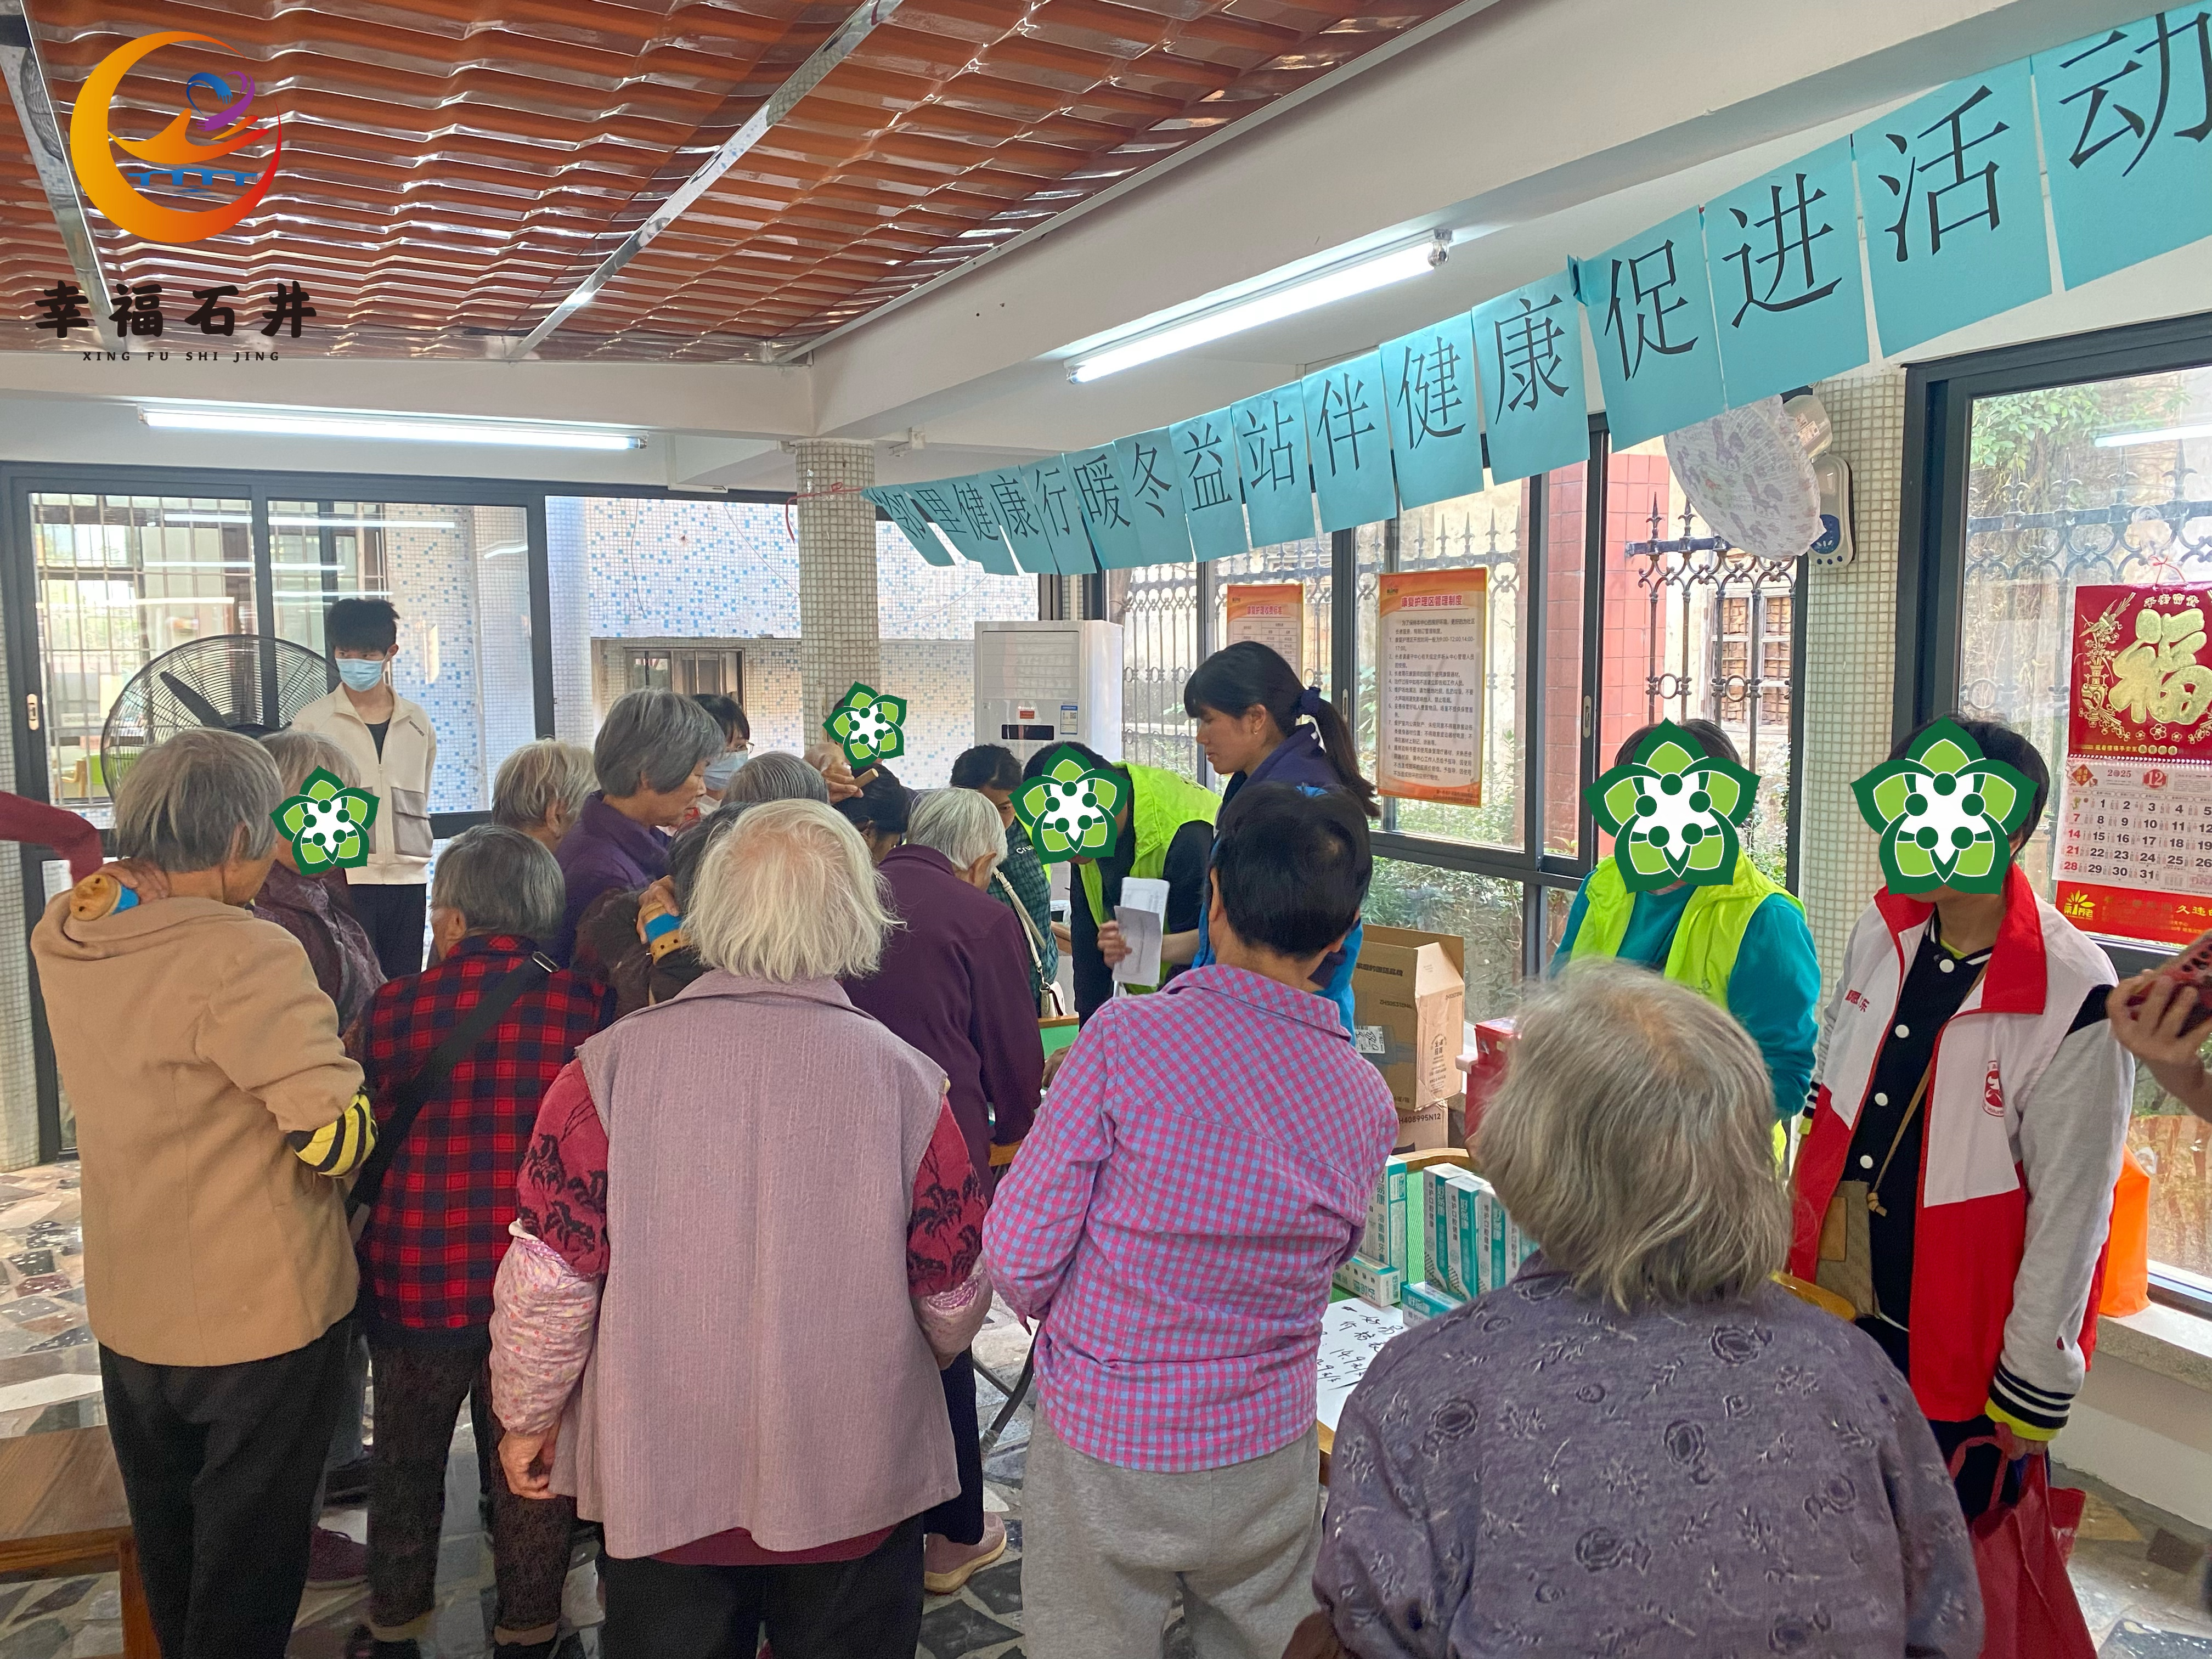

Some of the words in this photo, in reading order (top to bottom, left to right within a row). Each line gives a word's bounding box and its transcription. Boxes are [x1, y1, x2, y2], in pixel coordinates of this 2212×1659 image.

[1401, 595, 1463, 608] 康复护理区管理制度
[2108, 608, 2212, 725] 福
[2147, 771, 2163, 786] 12
[2101, 799, 2105, 808] 1
[2123, 801, 2130, 809] 2
[2148, 803, 2155, 811] 3
[2175, 805, 2183, 813] 4
[2204, 806, 2212, 815] 5
[2073, 814, 2080, 822] 7
[2097, 816, 2104, 824] 8
[2121, 817, 2129, 826] 9
[2143, 820, 2157, 828] 10
[2172, 822, 2185, 831] 11
[2199, 823, 2212, 833] 12
[2068, 830, 2080, 838] 14
[2093, 832, 2105, 840] 15
[2117, 834, 2129, 843] 16
[2142, 836, 2156, 845] 17
[2170, 838, 2183, 848] 18
[2198, 841, 2212, 850] 19
[2066, 845, 2079, 855] 21
[2090, 848, 2104, 857] 22
[2114, 850, 2129, 860] 23
[2140, 853, 2155, 862] 24
[2168, 855, 2183, 865] 25
[2196, 858, 2212, 867] 26
[2064, 861, 2078, 870] 28
[2088, 864, 2102, 873] 29
[2112, 867, 2128, 876] 30
[2140, 870, 2154, 879] 31
